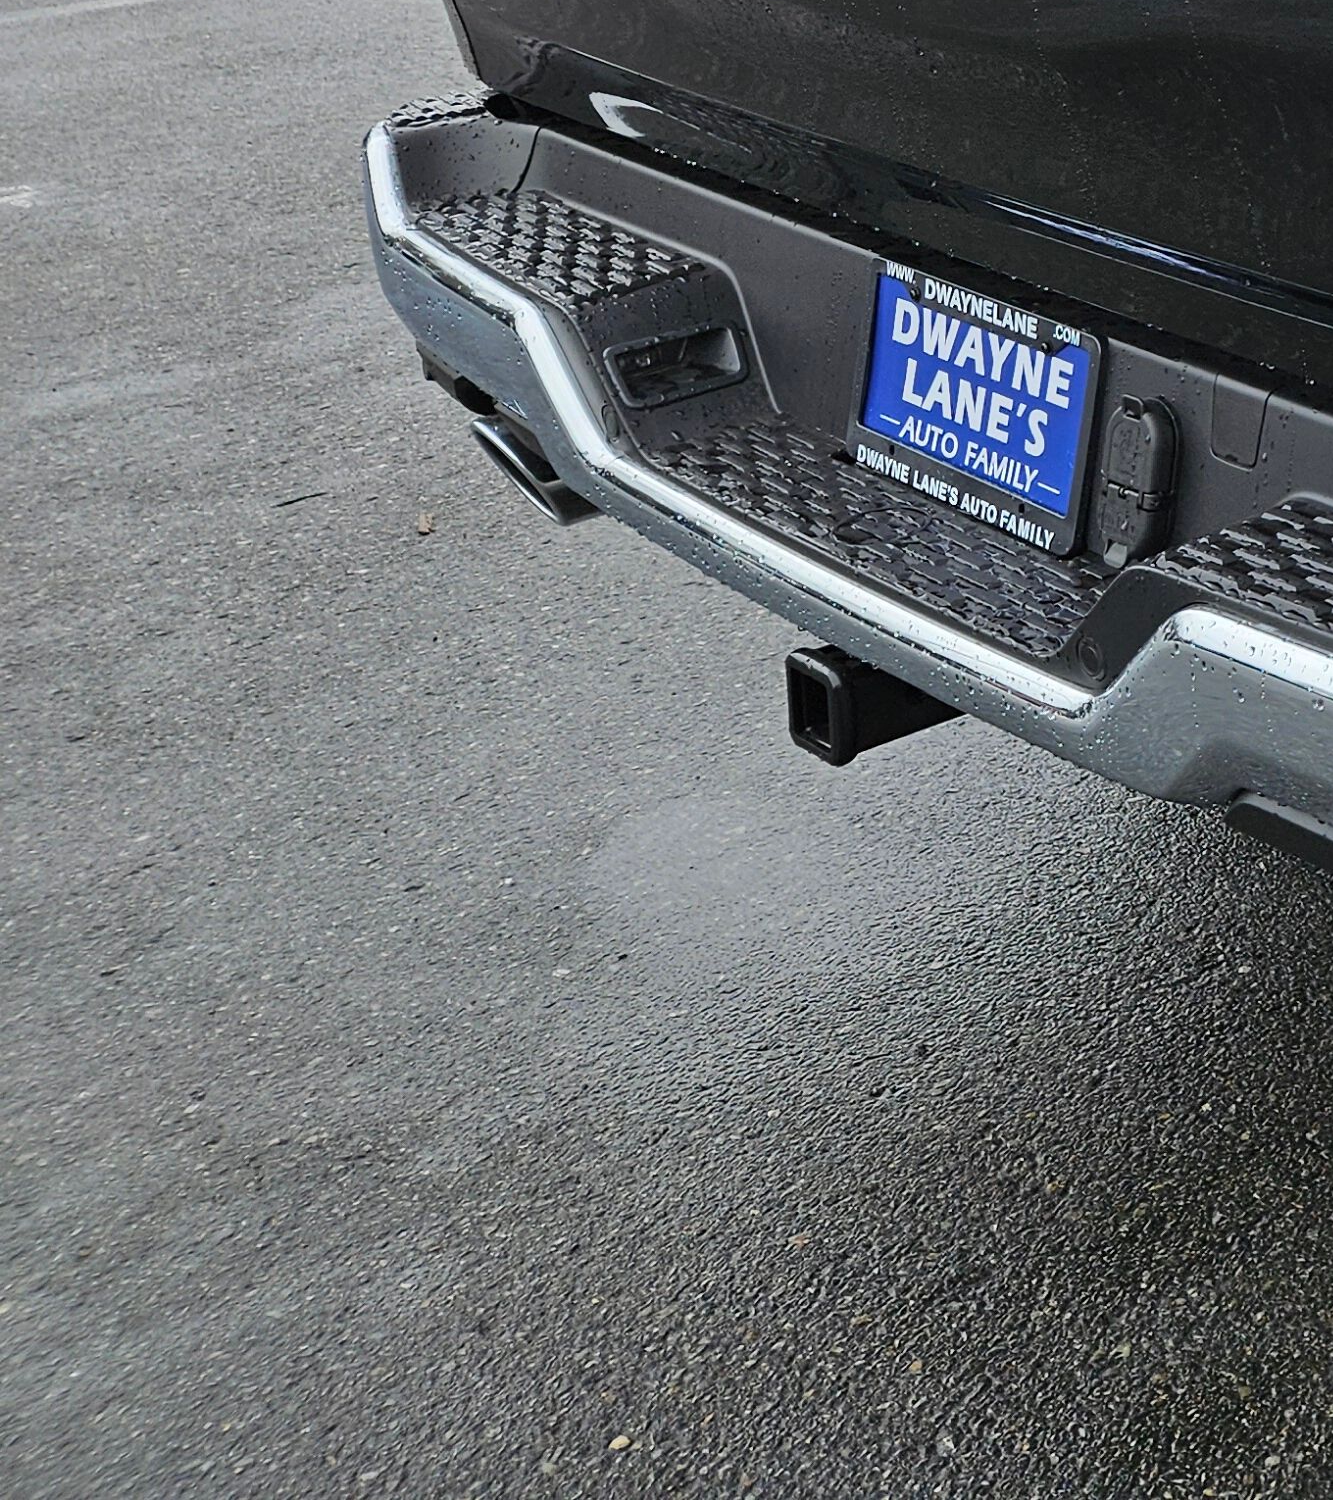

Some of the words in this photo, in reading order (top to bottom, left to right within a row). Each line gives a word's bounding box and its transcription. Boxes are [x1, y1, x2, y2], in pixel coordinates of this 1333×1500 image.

[892, 297, 1075, 409] DWAYNE
[924, 278, 1038, 340] DWAYNELANE
[899, 415, 959, 459] AUTO
[964, 441, 1039, 493] FAMILY
[902, 358, 1049, 458] LANE'S
[856, 443, 911, 484] DWAYNE
[912, 469, 959, 506] LANE'S
[960, 492, 998, 524] AUTO
[999, 509, 1055, 550] FAMILY
